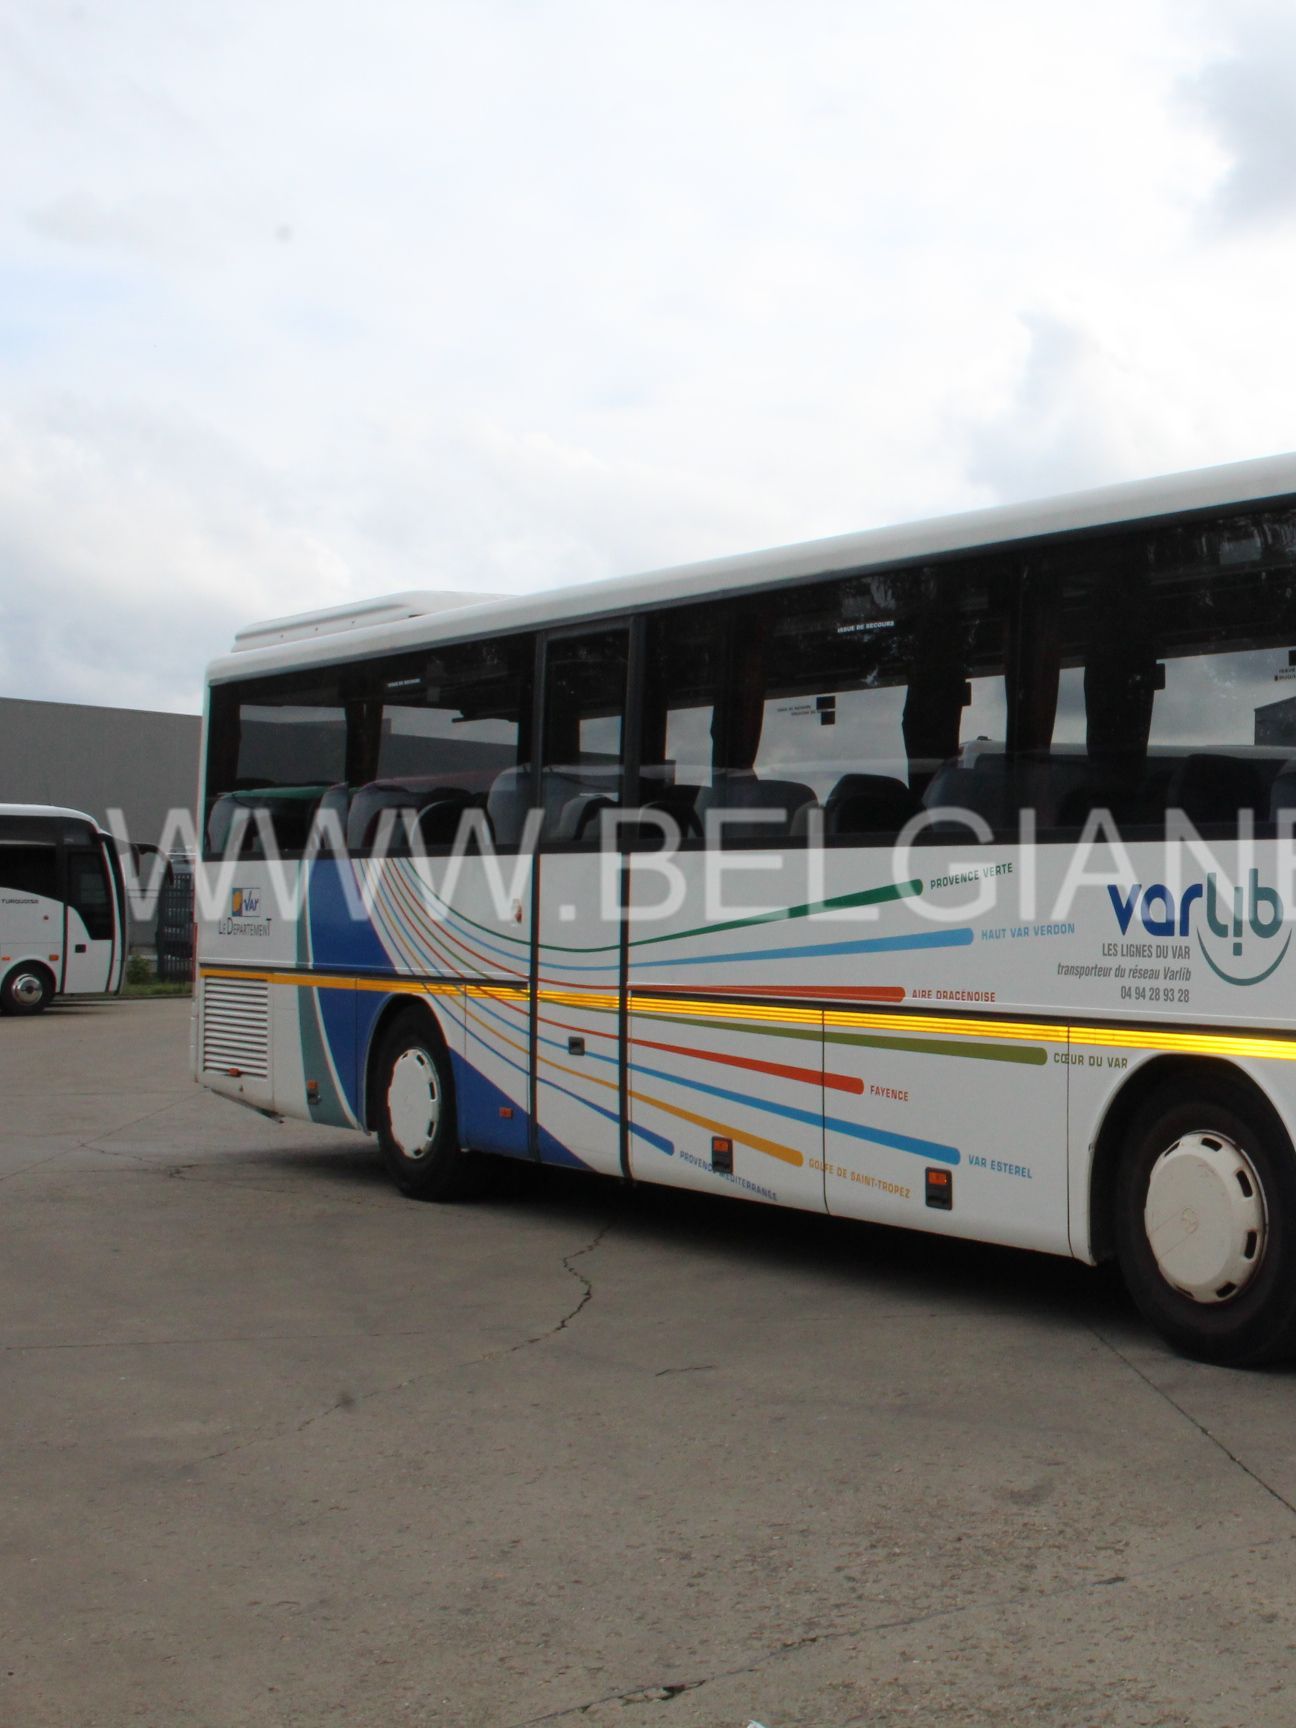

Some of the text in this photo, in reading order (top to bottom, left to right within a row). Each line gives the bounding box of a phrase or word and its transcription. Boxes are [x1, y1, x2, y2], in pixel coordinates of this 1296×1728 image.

[930, 861, 1014, 890] PROVENCE VERTE
[981, 922, 1076, 941] HAUT VAR VERDON
[1101, 942, 1191, 961] LES LIGNES DU VAR
[1056, 962, 1192, 982] transporteur du réseau Varlib
[912, 988, 933, 999] AIRE
[1120, 985, 1190, 1003] 04 94 28 93 28
[1088, 1055, 1104, 1068] DU
[1106, 1056, 1129, 1070] VAR
[870, 1084, 910, 1102] FAYENCE
[680, 1149, 716, 1174] PROVENC
[968, 1153, 1033, 1180] VAR ESTEREL
[808, 1157, 913, 1200] GOLFE DE SAINT-TROPEZ
